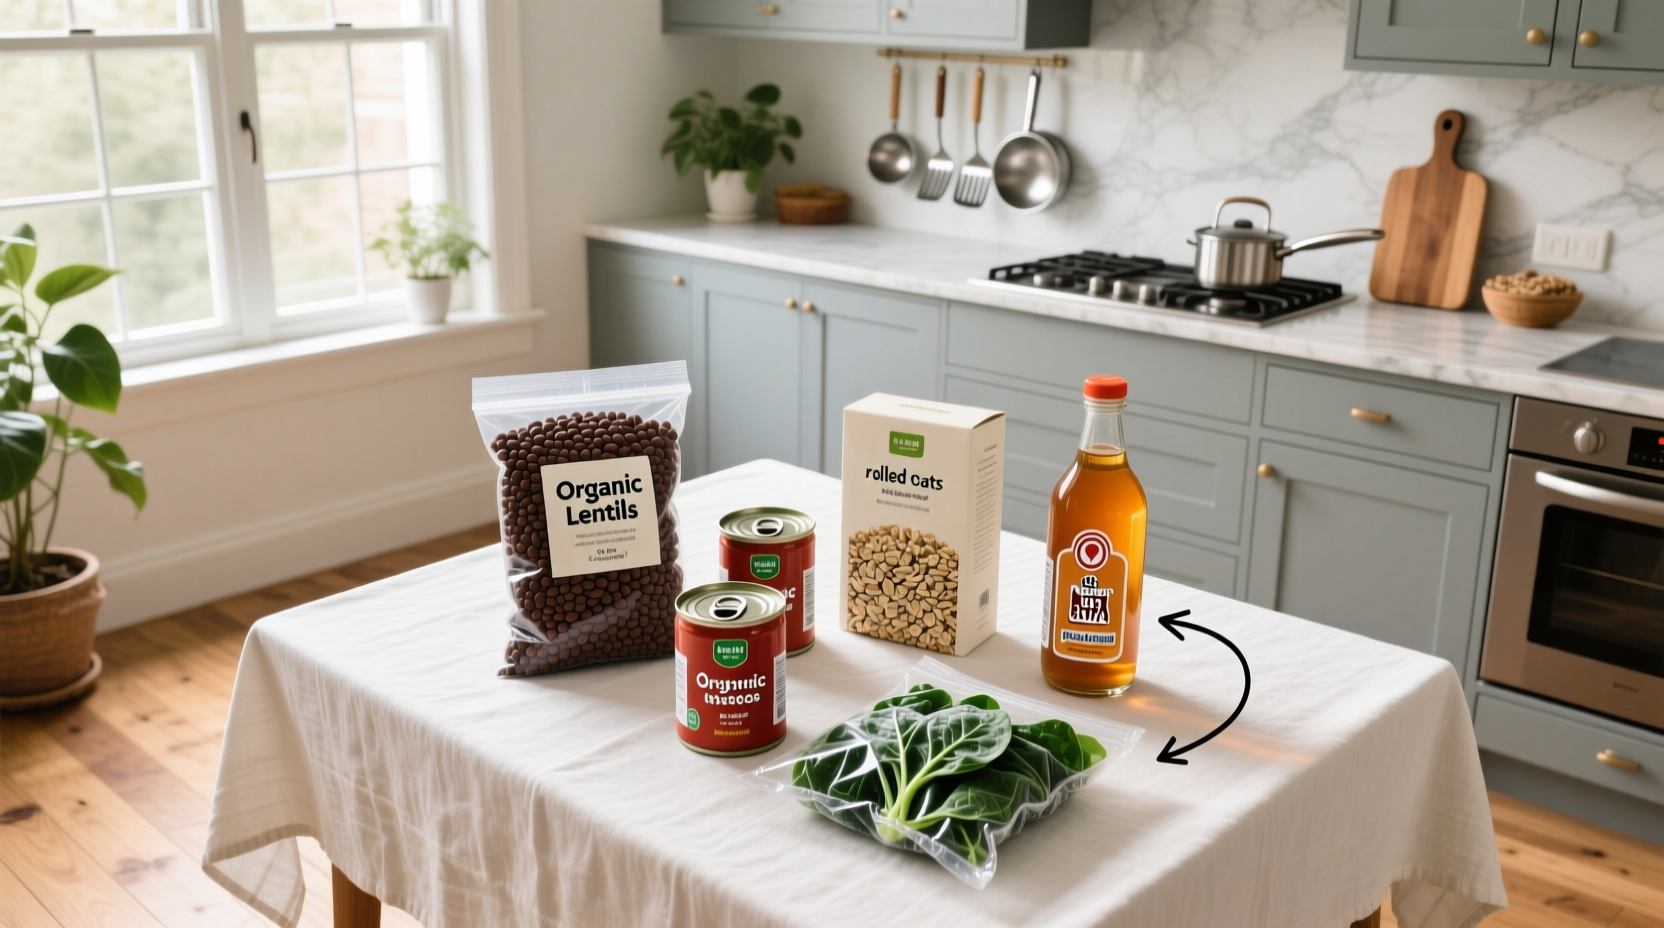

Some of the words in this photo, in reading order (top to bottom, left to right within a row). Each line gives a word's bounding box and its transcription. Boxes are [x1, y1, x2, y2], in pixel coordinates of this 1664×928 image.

[865, 465, 906, 484] rolled
[556, 473, 643, 504] Organic
[566, 499, 639, 526] Lentils
